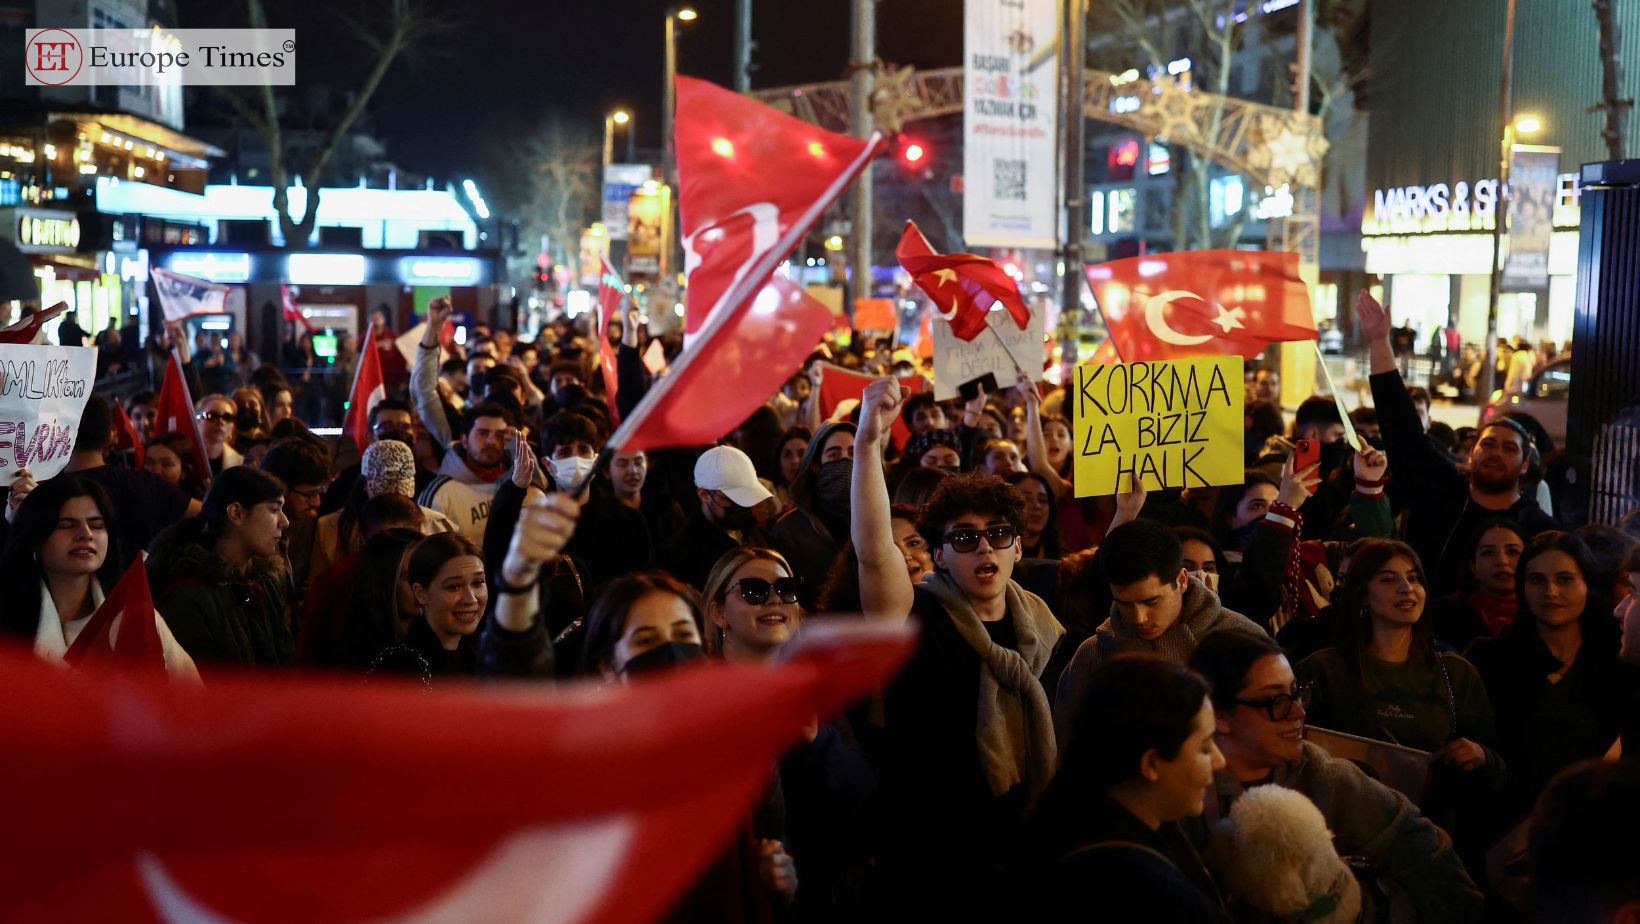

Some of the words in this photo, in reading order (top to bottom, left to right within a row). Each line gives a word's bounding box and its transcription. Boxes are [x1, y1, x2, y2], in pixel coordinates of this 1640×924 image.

[1374, 182, 1450, 221] MARKS
[1452, 181, 1470, 218] &
[1079, 362, 1231, 418] KORKMA
[1082, 423, 1122, 456] LA
[1138, 410, 1210, 448] BİZİZ
